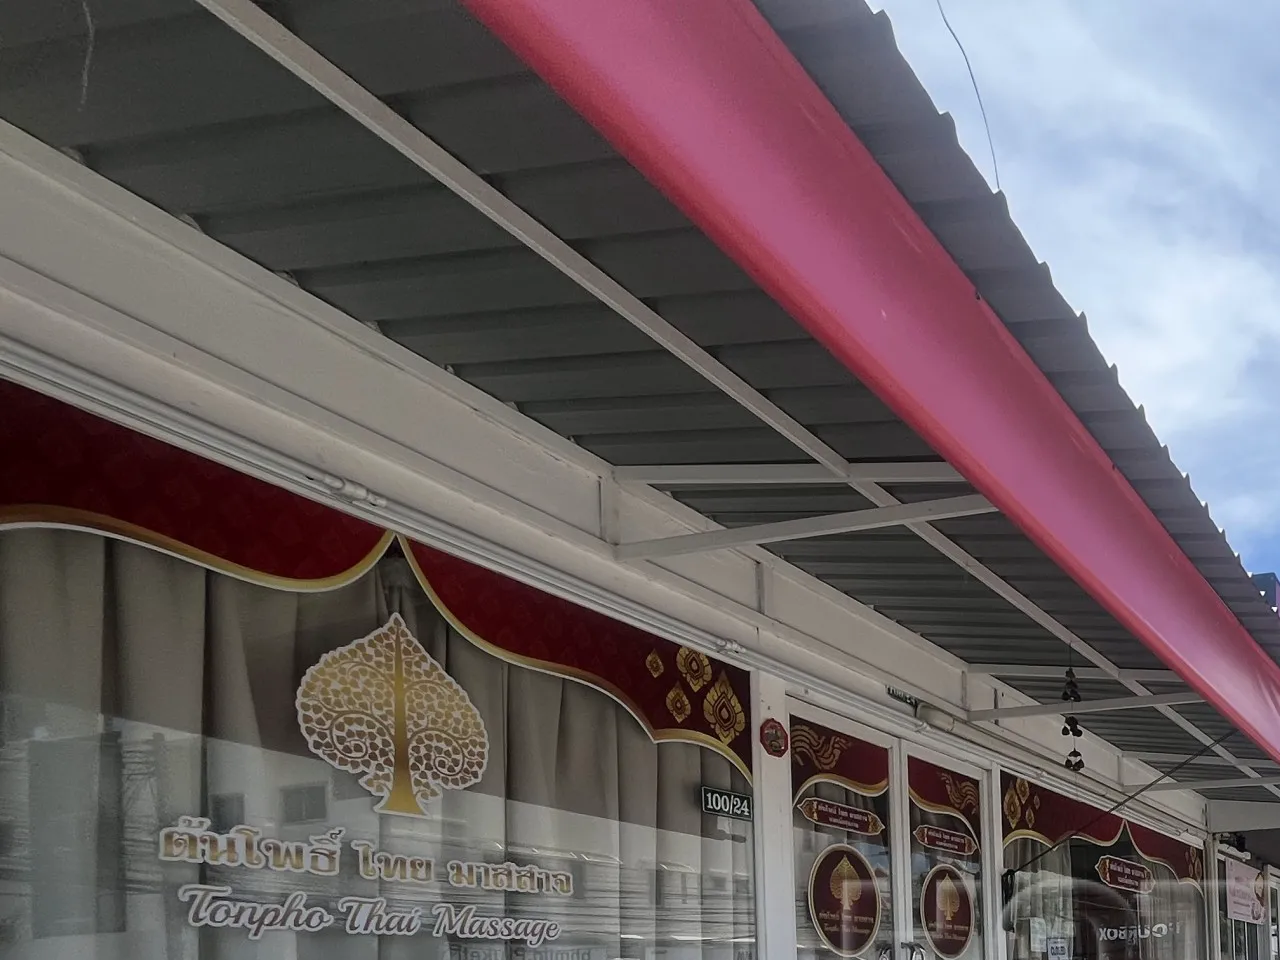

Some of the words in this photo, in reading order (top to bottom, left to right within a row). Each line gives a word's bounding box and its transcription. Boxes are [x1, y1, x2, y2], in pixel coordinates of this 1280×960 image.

[706, 792, 750, 816] 100/24
[160, 816, 345, 876] ต้นโพธิ์
[352, 841, 434, 882] ไทย
[448, 861, 573, 896] มาสสาจ
[179, 884, 334, 940] Tonpho
[338, 897, 421, 935] Thai
[432, 904, 559, 947] Massage
